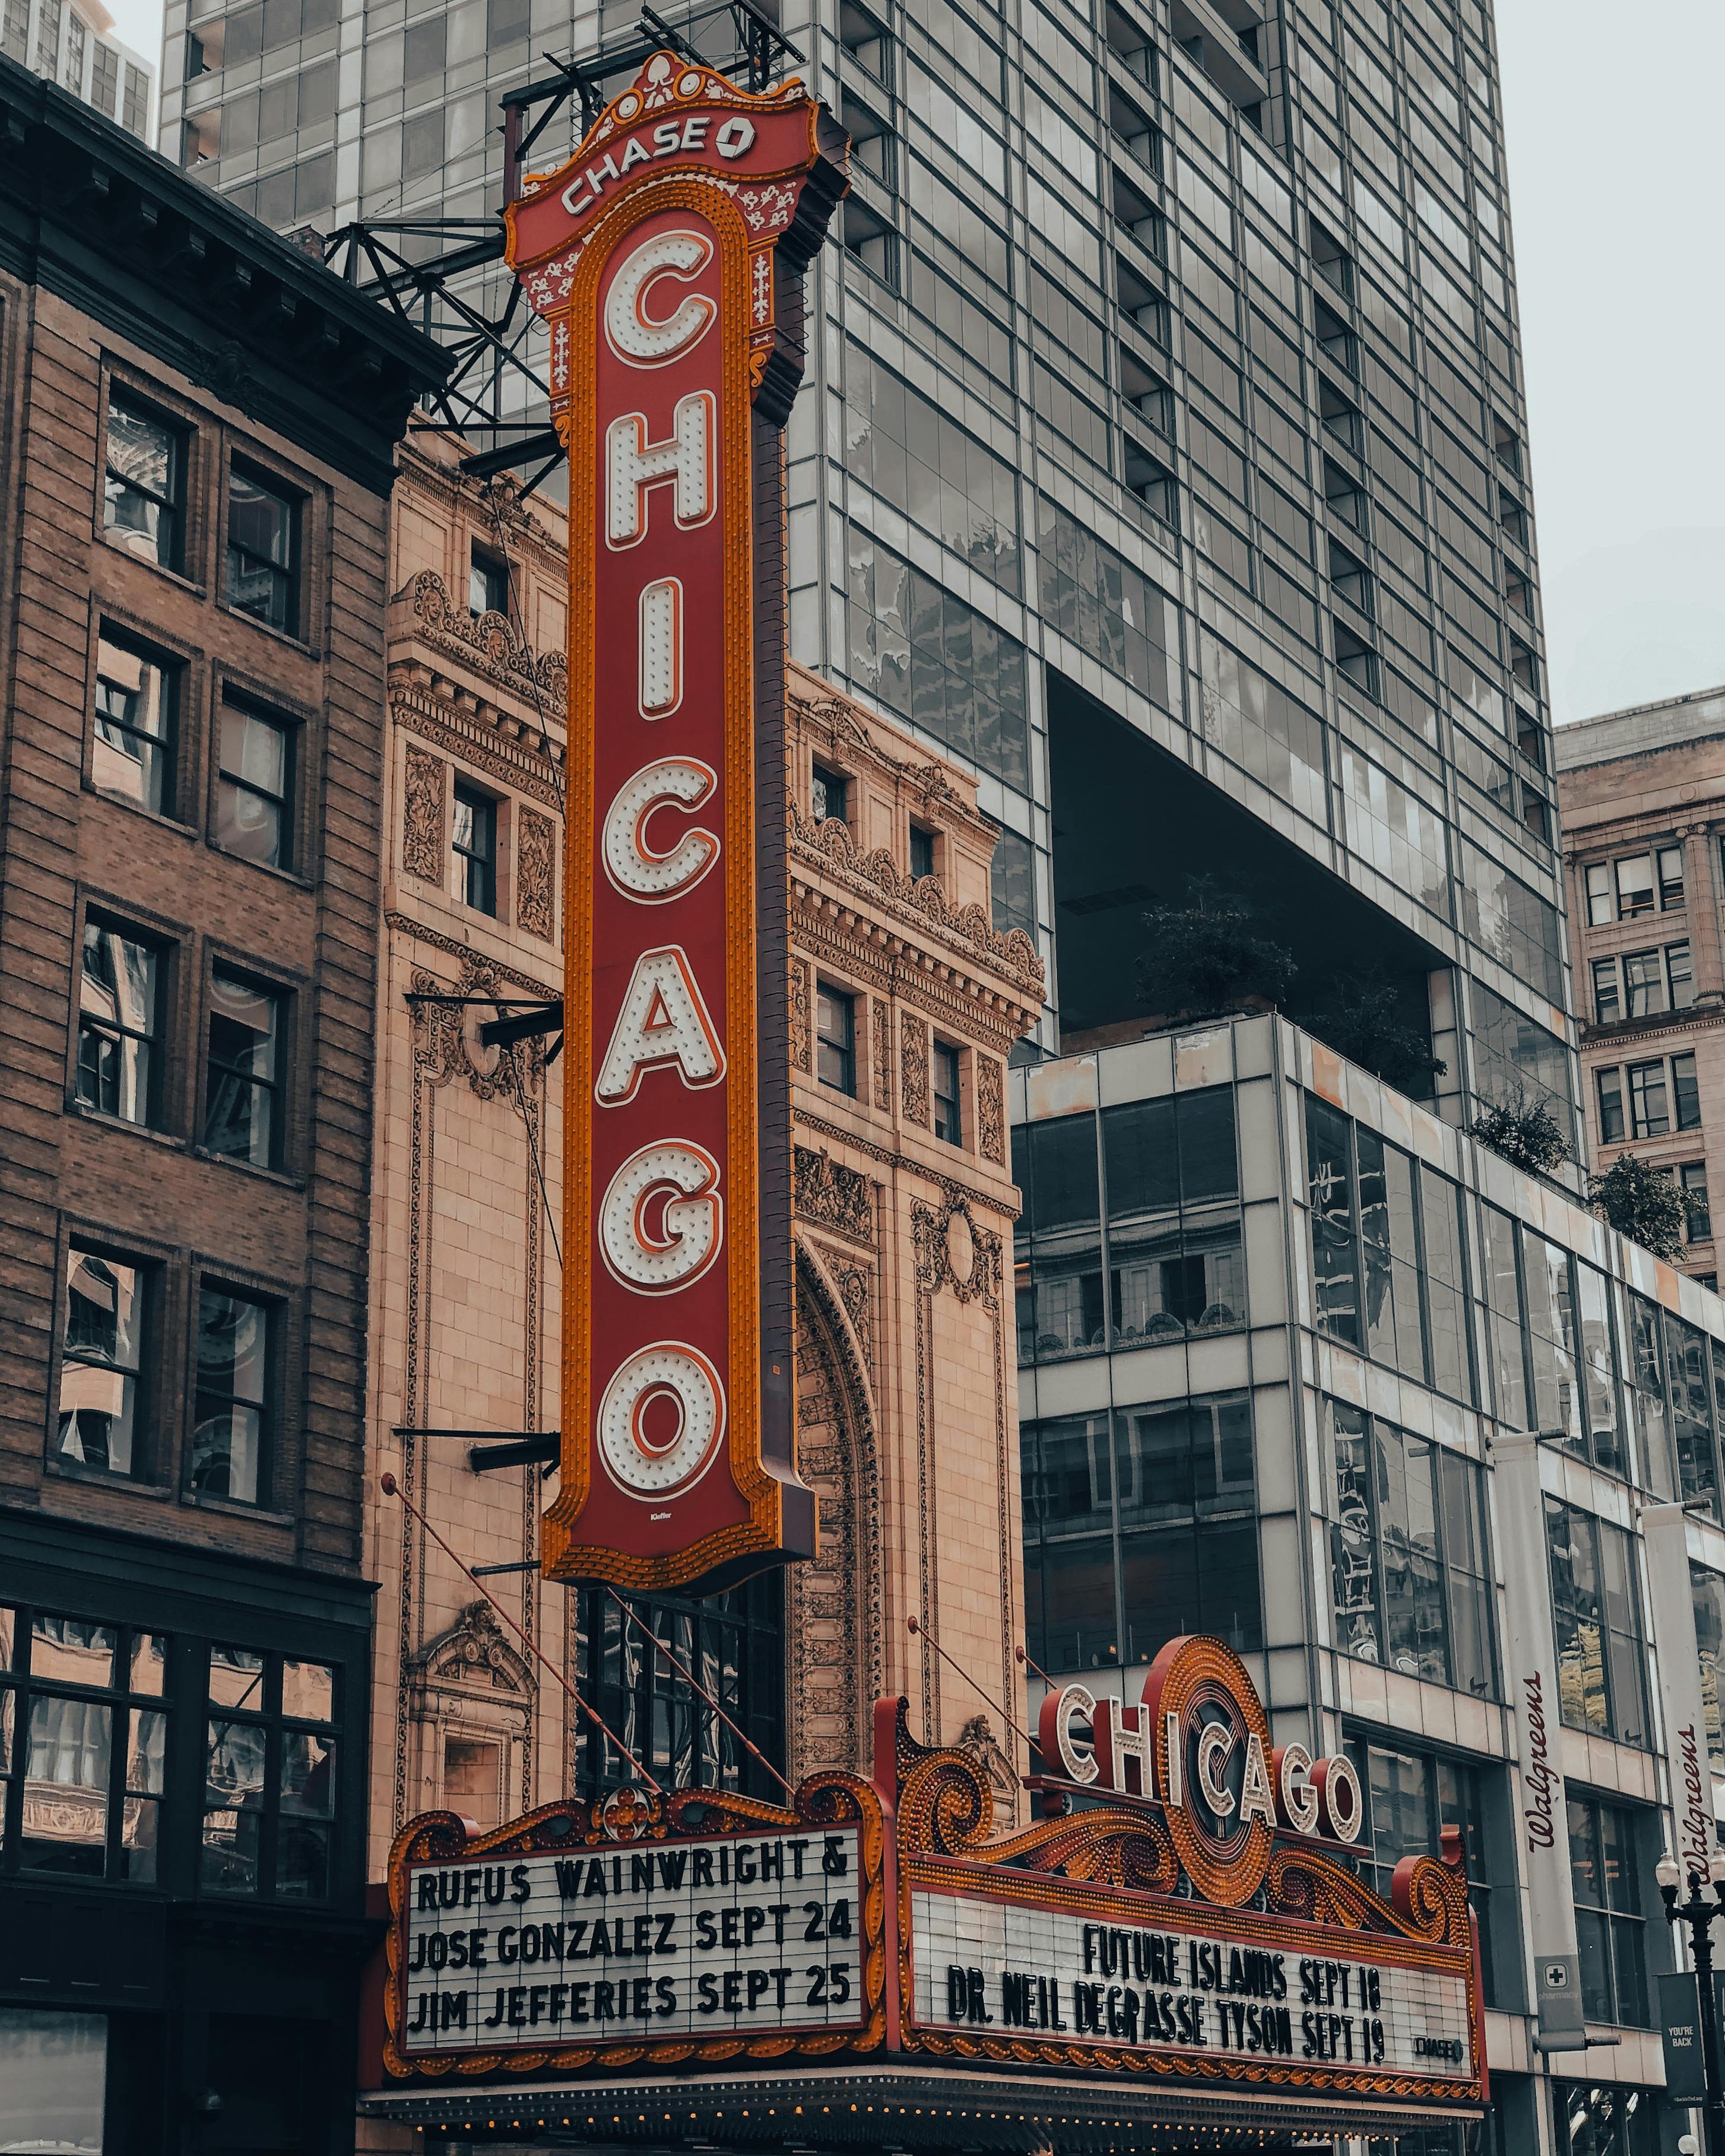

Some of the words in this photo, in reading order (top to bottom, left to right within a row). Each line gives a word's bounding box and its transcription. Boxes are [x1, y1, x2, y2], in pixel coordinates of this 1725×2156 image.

[561, 116, 711, 215] CHASE
[595, 229, 727, 1503] CHICAGO
[1054, 1682, 1362, 1843] CHICAGO
[1523, 1670, 1560, 1853] Walgreens
[1678, 1723, 1714, 1889] Walgreens
[417, 1864, 532, 1911] RUFUS
[554, 1838, 808, 1900] WAINWRIGHT
[822, 1835, 848, 1876] &
[408, 1927, 488, 1972] JOSE
[497, 1912, 677, 1964] GONZALEZ
[695, 1903, 790, 1951] SEPT
[802, 1898, 852, 1942] 24
[1083, 1923, 1182, 1987] FUTURE
[1190, 1939, 1288, 2001] ISLANDS
[1299, 1958, 1351, 2009] SEPT
[1359, 1966, 1381, 2013] 18
[407, 1990, 468, 2033] JIM
[484, 1975, 677, 2028] JEFFERIES
[696, 1967, 792, 2014] SEPT
[805, 1961, 851, 2007] 25
[948, 1964, 994, 2024] DR.
[1002, 1971, 1068, 2032] NEIL
[1216, 1998, 1293, 2056] TYSON
[1301, 2009, 1354, 2062] SEPT
[1363, 2017, 1385, 2063] 19
[1668, 2025, 1694, 2036] YOU'RE
[1672, 2037, 1692, 2047] BACK
